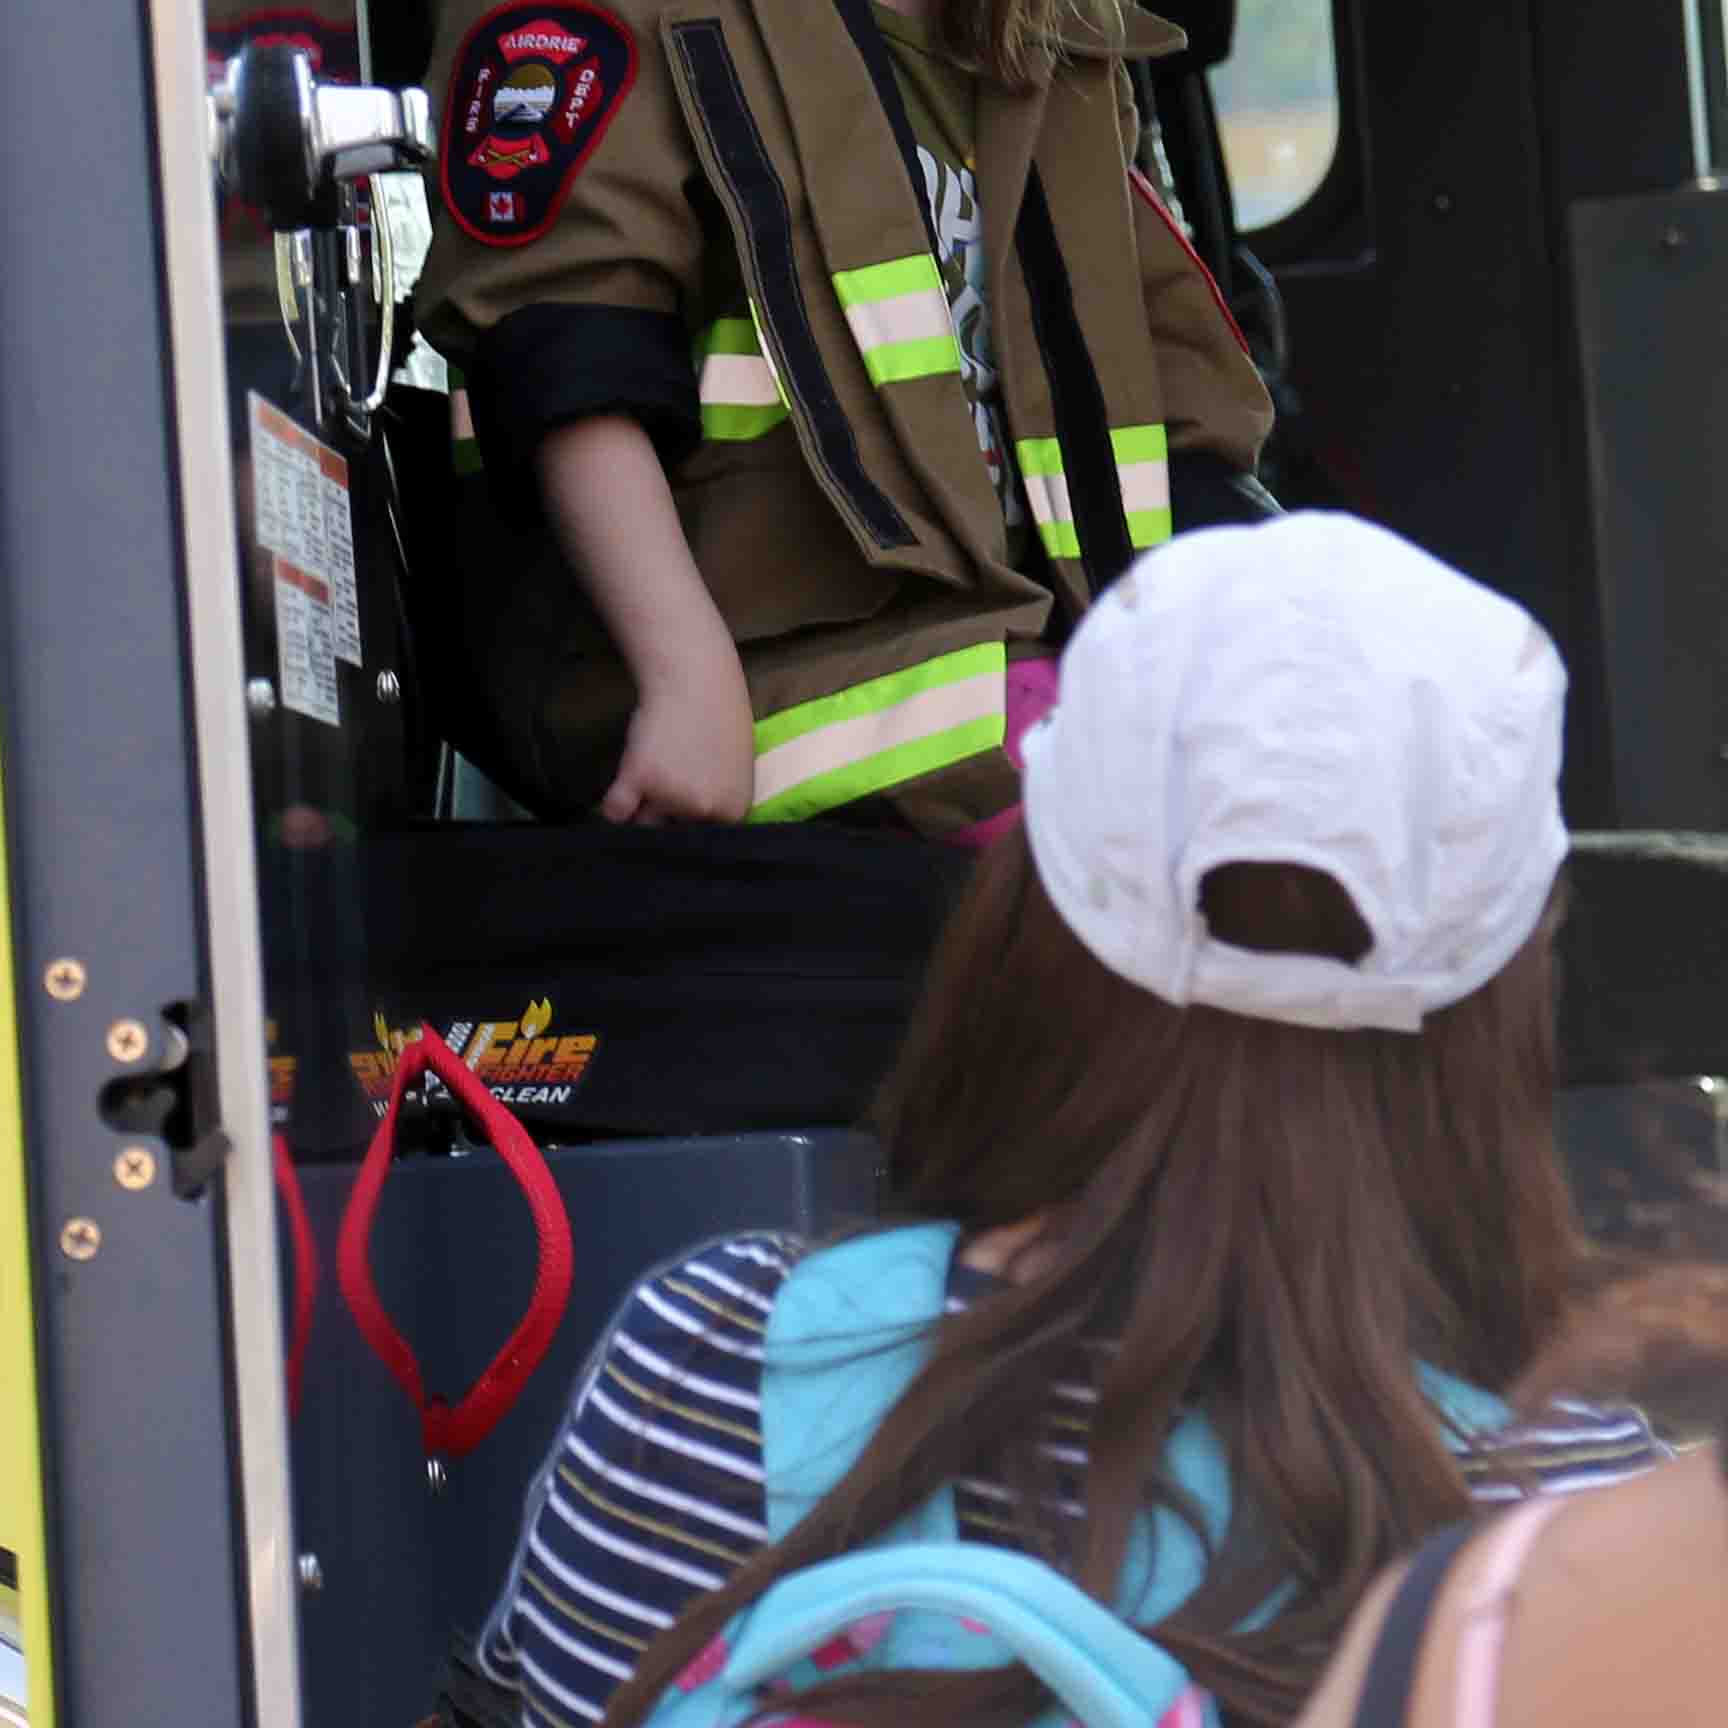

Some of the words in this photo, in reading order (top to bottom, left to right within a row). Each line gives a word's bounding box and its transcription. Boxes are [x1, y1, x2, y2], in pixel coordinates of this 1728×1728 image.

[505, 31, 580, 54] AIRDRIE
[564, 68, 596, 130] DEPT
[463, 998, 600, 1068] Fire
[475, 1062, 584, 1084] FIGHTER
[489, 1085, 573, 1104] CLEAN
